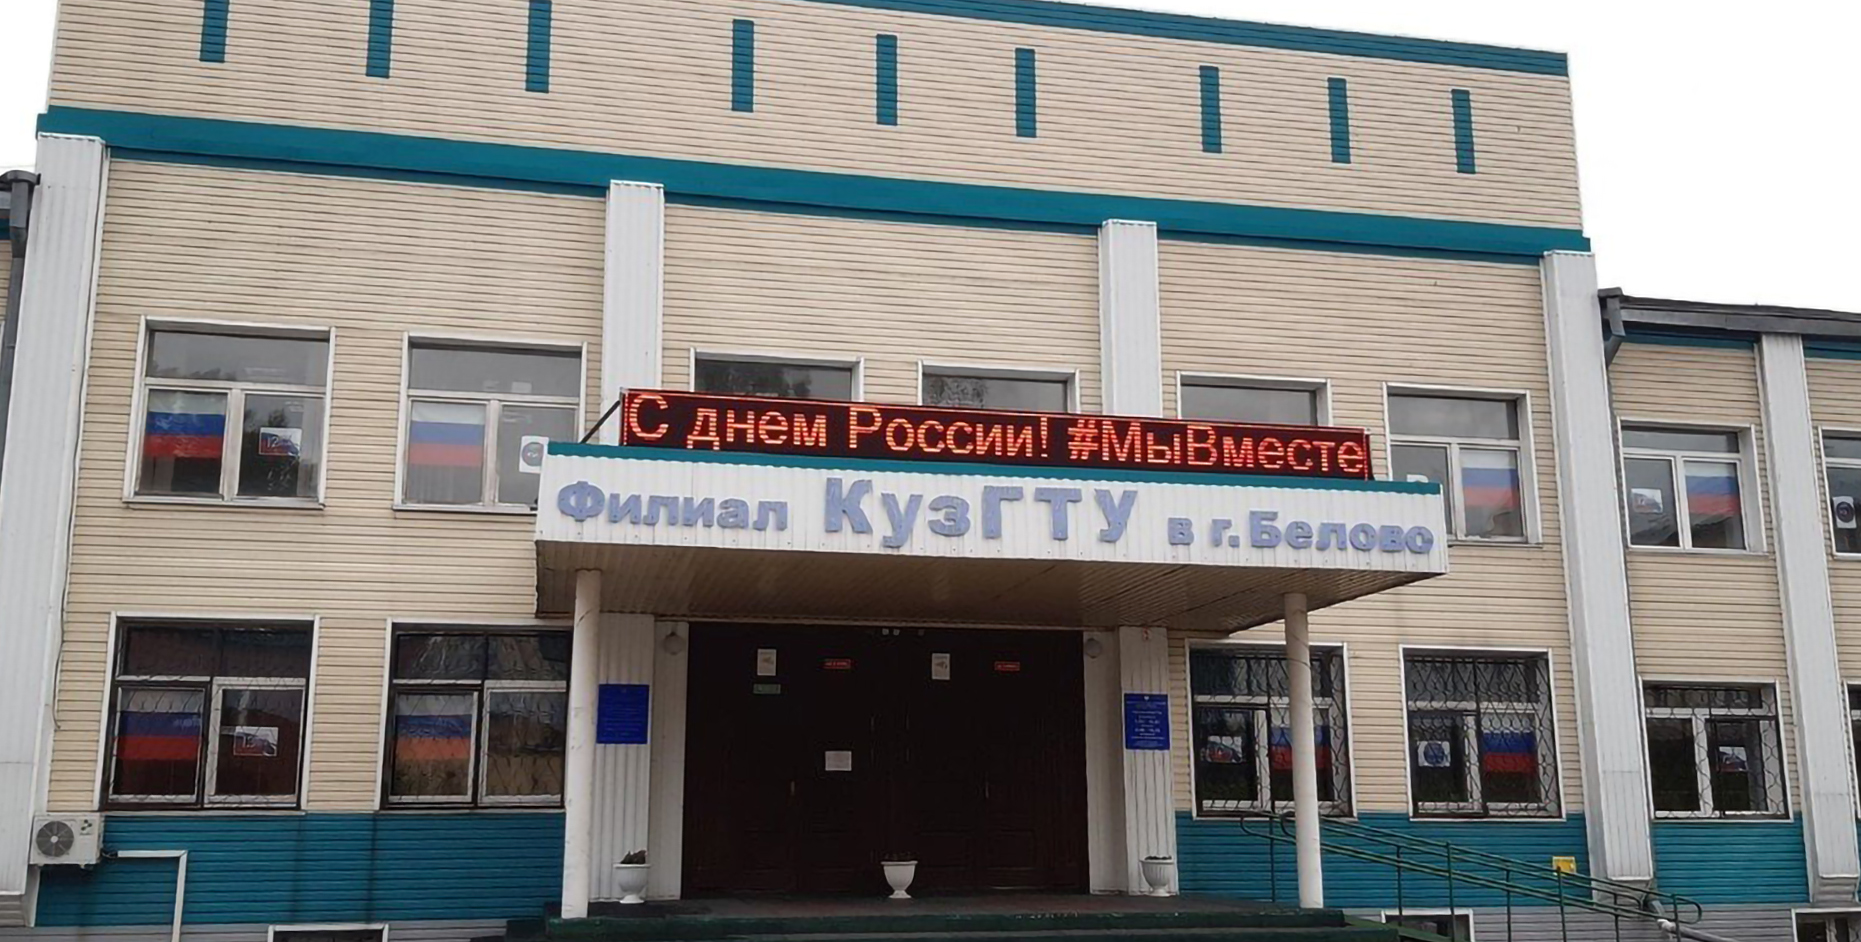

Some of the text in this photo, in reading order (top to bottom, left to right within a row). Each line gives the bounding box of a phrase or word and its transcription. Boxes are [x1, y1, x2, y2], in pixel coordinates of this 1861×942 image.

[628, 393, 1366, 474] С днем России! #МыВместе
[557, 480, 789, 532] Филиал
[824, 476, 1139, 549] КузГТУ
[1167, 516, 1195, 546] в
